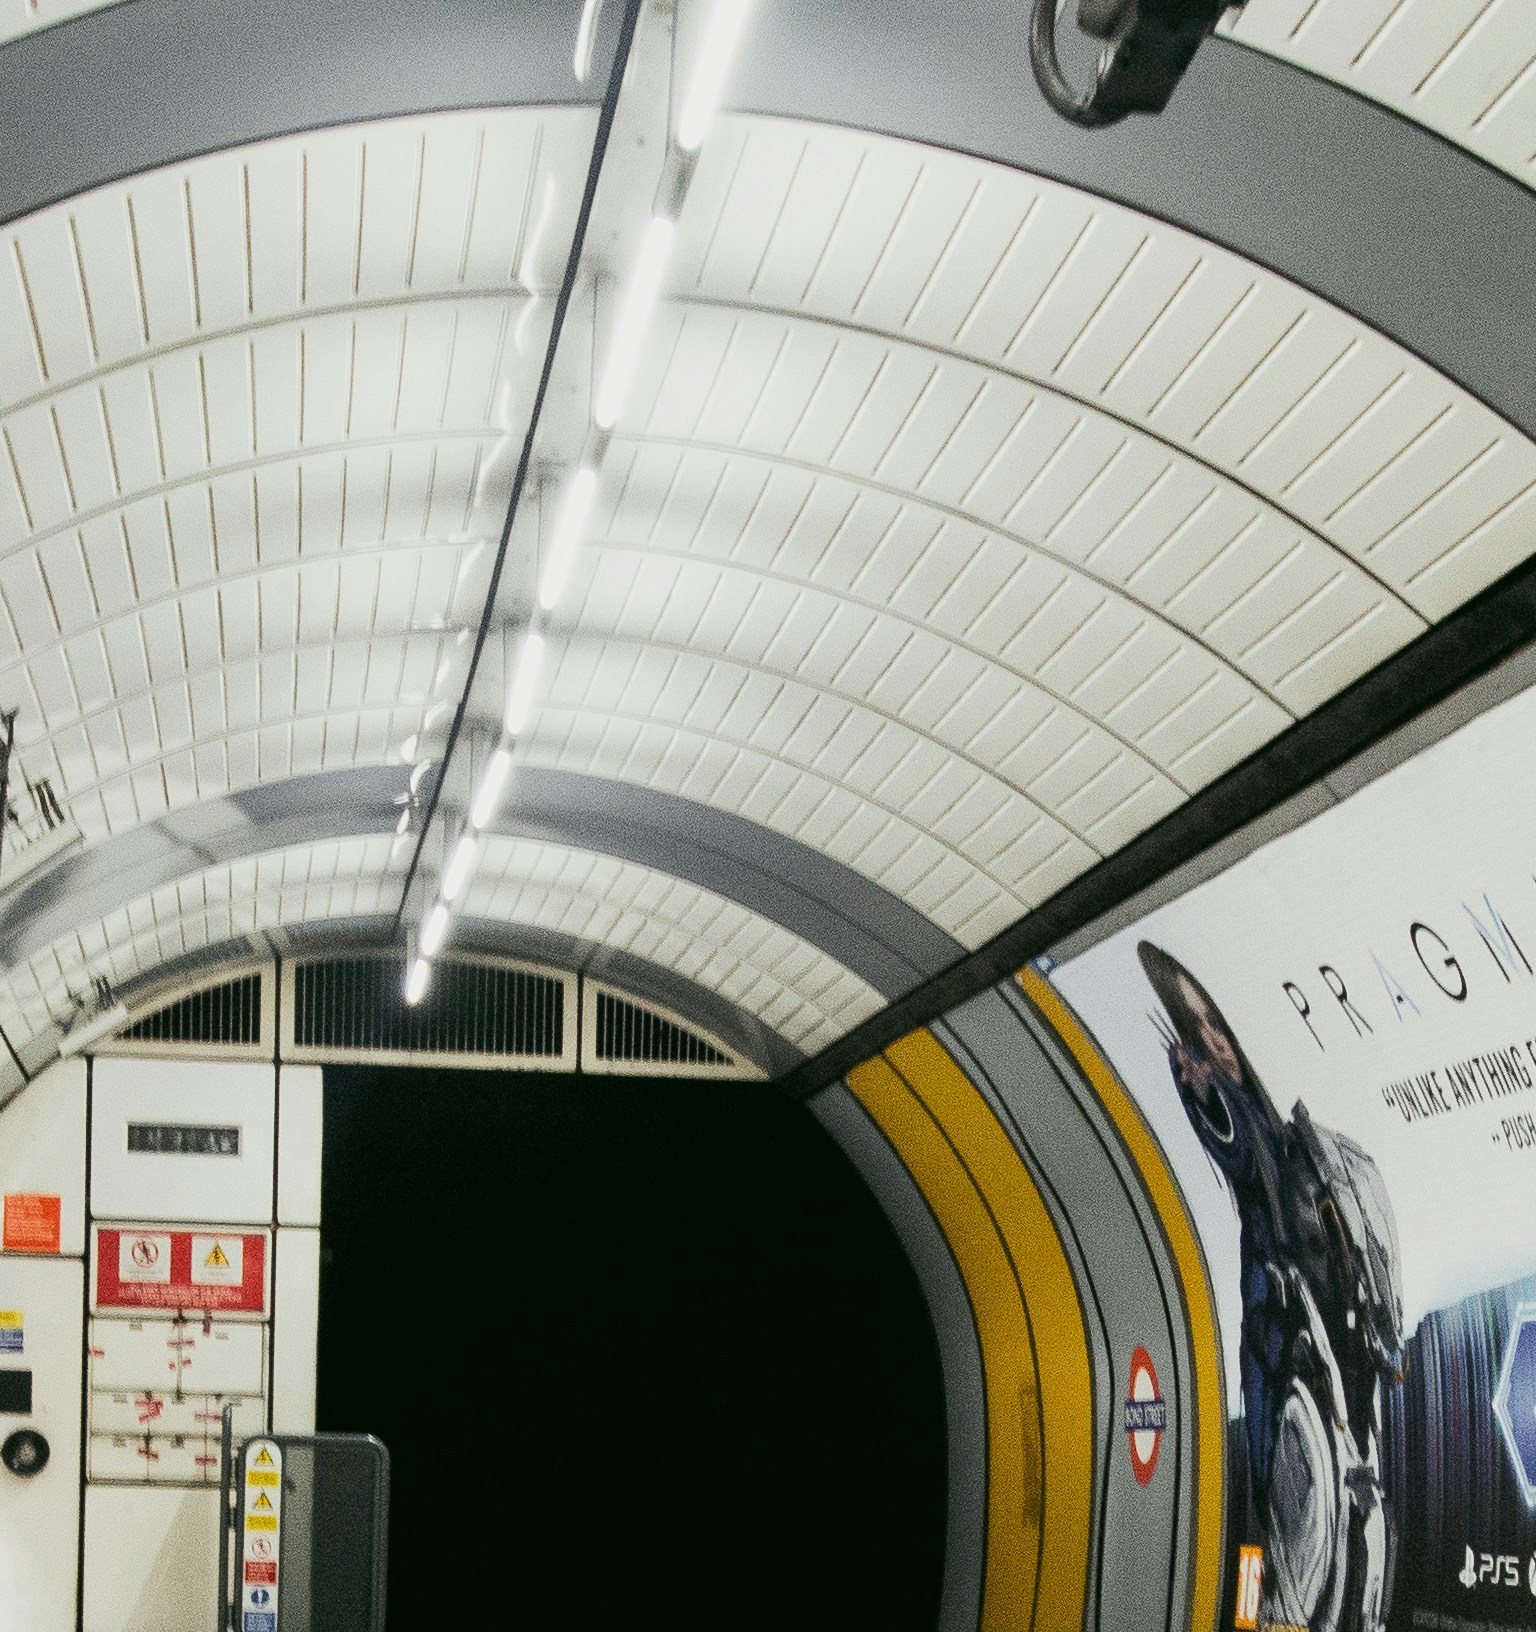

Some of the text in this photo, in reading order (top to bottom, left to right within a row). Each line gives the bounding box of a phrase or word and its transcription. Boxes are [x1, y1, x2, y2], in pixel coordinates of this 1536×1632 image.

[1445, 1046, 1533, 1107] ANYTHING
[1239, 1556, 1262, 1621] 16
[1480, 1553, 1519, 1587] PS5
